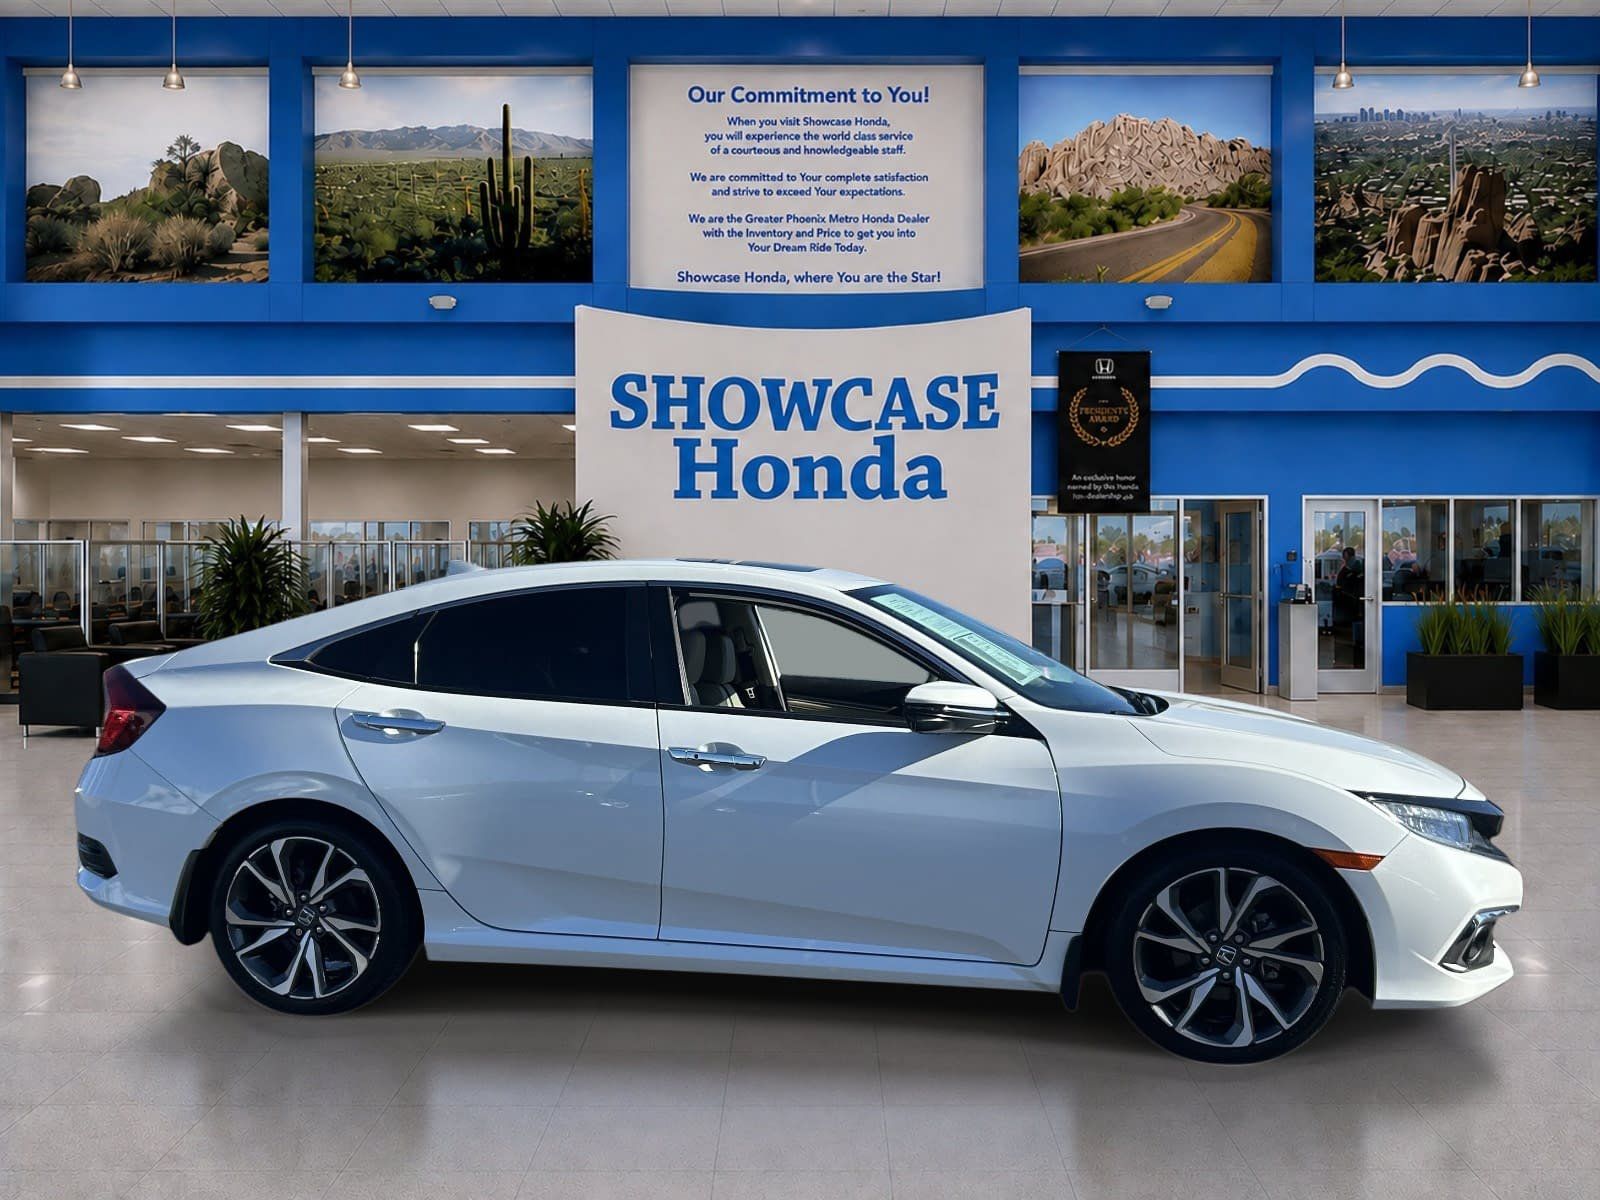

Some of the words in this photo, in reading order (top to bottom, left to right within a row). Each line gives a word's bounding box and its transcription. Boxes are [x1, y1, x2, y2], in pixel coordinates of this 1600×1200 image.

[687, 85, 727, 104] Our
[730, 85, 857, 104] Commitment
[861, 87, 883, 104] to
[886, 85, 930, 104] You!
[726, 115, 757, 127] When
[758, 118, 778, 129] you
[779, 116, 801, 127] visit
[802, 116, 853, 127] Showcase
[854, 116, 891, 128] Honda,
[704, 132, 724, 144] you
[725, 130, 744, 141] will
[744, 130, 802, 144] experience
[802, 130, 820, 141] the
[821, 130, 852, 142] world
[852, 130, 878, 142] class
[878, 130, 914, 142] service
[709, 144, 722, 155] of
[722, 147, 730, 155] a
[730, 146, 781, 156] courteous
[782, 144, 802, 155] and
[881, 144, 907, 155] staff.
[689, 172, 708, 183] We
[708, 174, 727, 183] are
[727, 171, 784, 183] committed
[785, 173, 798, 183] to
[799, 172, 823, 183] Your
[824, 171, 872, 185] complete
[873, 171, 929, 183] satisfaction
[711, 185, 731, 197] and
[731, 186, 761, 197] strive
[762, 187, 775, 197] to
[775, 186, 812, 197] exceed
[813, 186, 838, 197] Your
[838, 186, 906, 200] expectations.
[688, 213, 707, 225] We
[707, 215, 725, 225] are
[725, 213, 744, 224] the
[744, 213, 785, 224] Greater
[785, 213, 827, 224] Phoenix
[828, 213, 860, 224] Metro
[861, 213, 895, 224] Honda
[896, 213, 931, 224] Dealer
[702, 227, 725, 238] with
[726, 227, 744, 239] the
[745, 227, 794, 241] Inventory
[794, 227, 815, 239] and
[816, 227, 842, 239] Price
[843, 229, 855, 239] to
[856, 228, 875, 241] get
[876, 230, 895, 241] you
[896, 227, 917, 239] into
[747, 242, 772, 253] Your
[772, 242, 808, 253] Dream
[809, 242, 833, 253] Ride
[833, 242, 868, 255] Today.
[676, 270, 741, 284] Showcase
[744, 270, 790, 286] Honda,
[793, 270, 834, 284] where
[836, 271, 861, 284] You
[863, 274, 884, 284] are
[886, 270, 908, 284] the
[910, 270, 941, 284] Star!
[609, 372, 1001, 432] SHOWCASE
[672, 433, 949, 501] Honda
